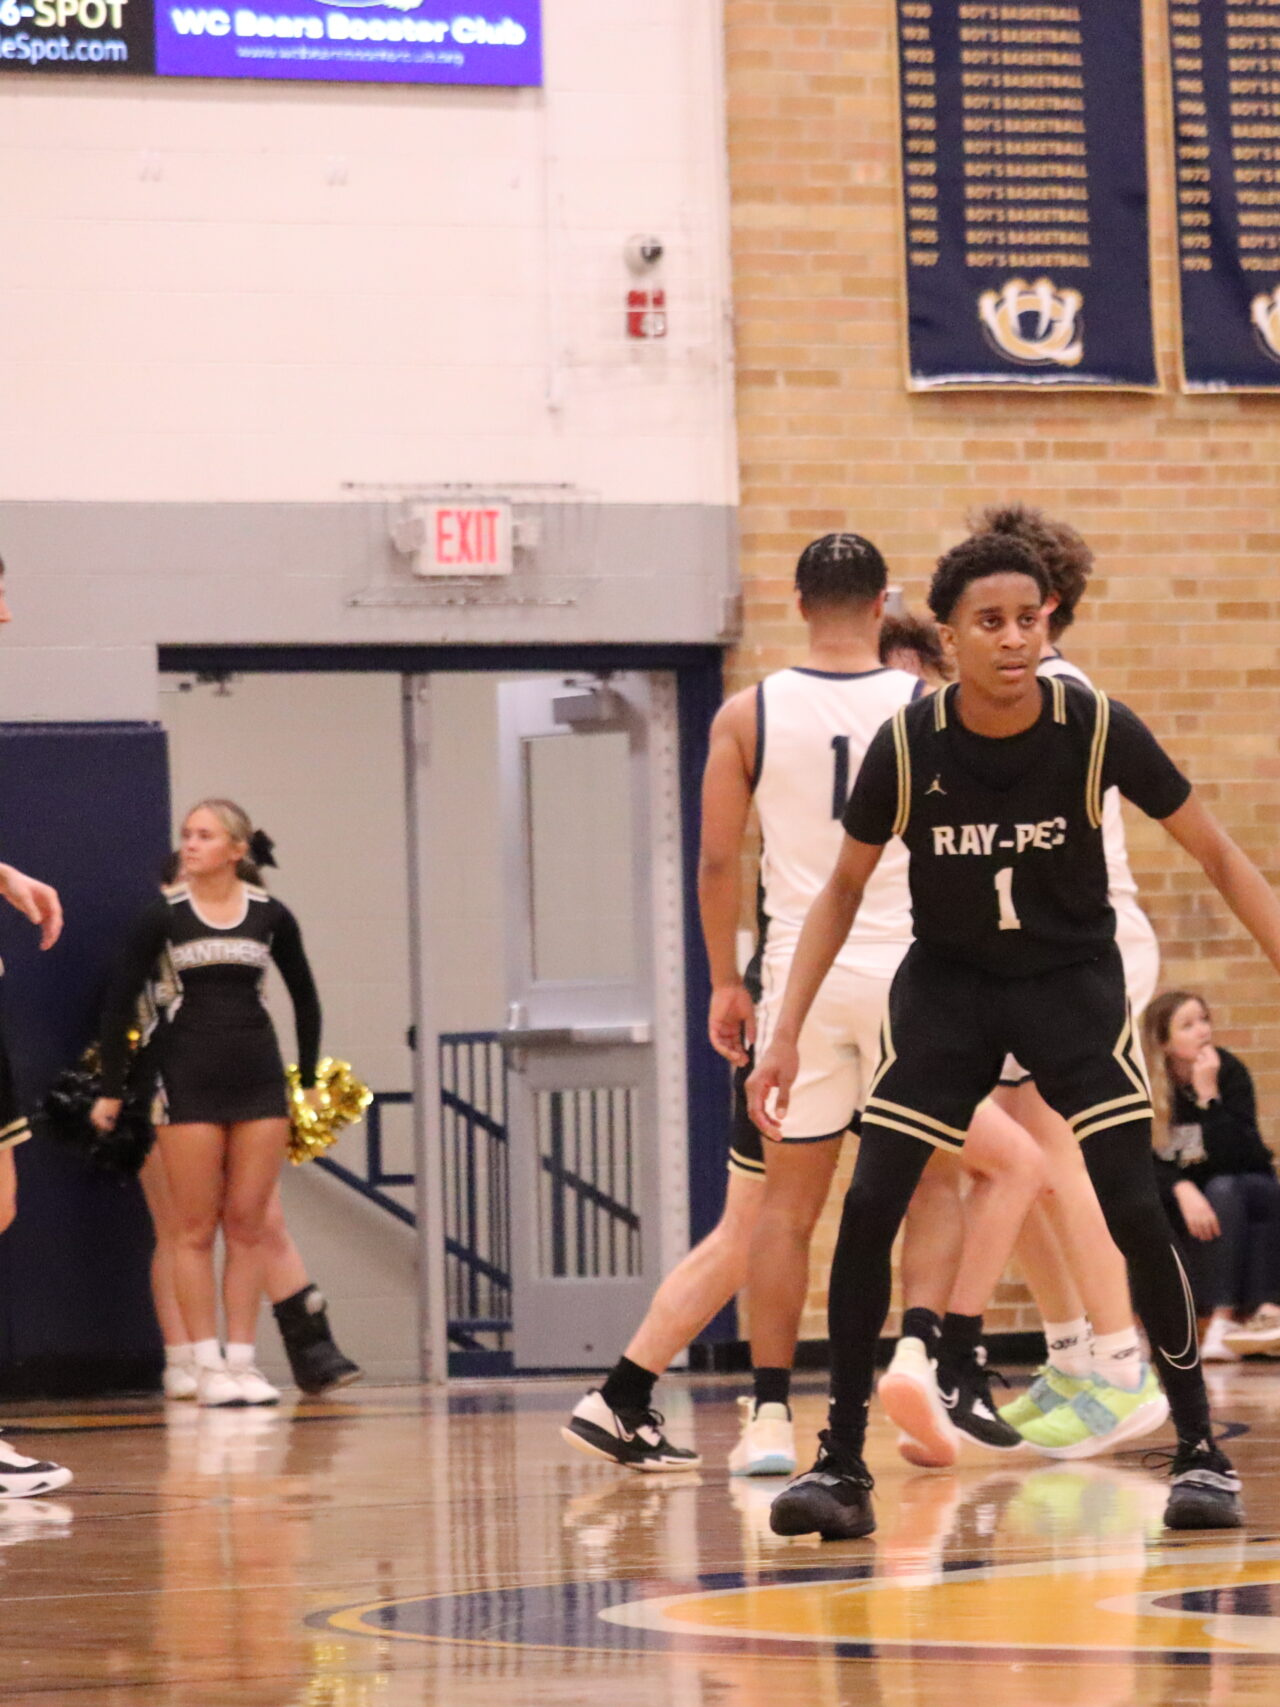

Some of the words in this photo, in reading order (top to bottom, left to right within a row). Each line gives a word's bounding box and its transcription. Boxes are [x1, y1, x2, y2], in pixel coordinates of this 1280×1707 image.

[170, 7, 231, 36] WC
[234, 8, 324, 39] Bears
[326, 11, 450, 43] Booster
[450, 15, 527, 46] Club
[435, 510, 499, 566] EXIT
[994, 867, 1021, 931] 1
